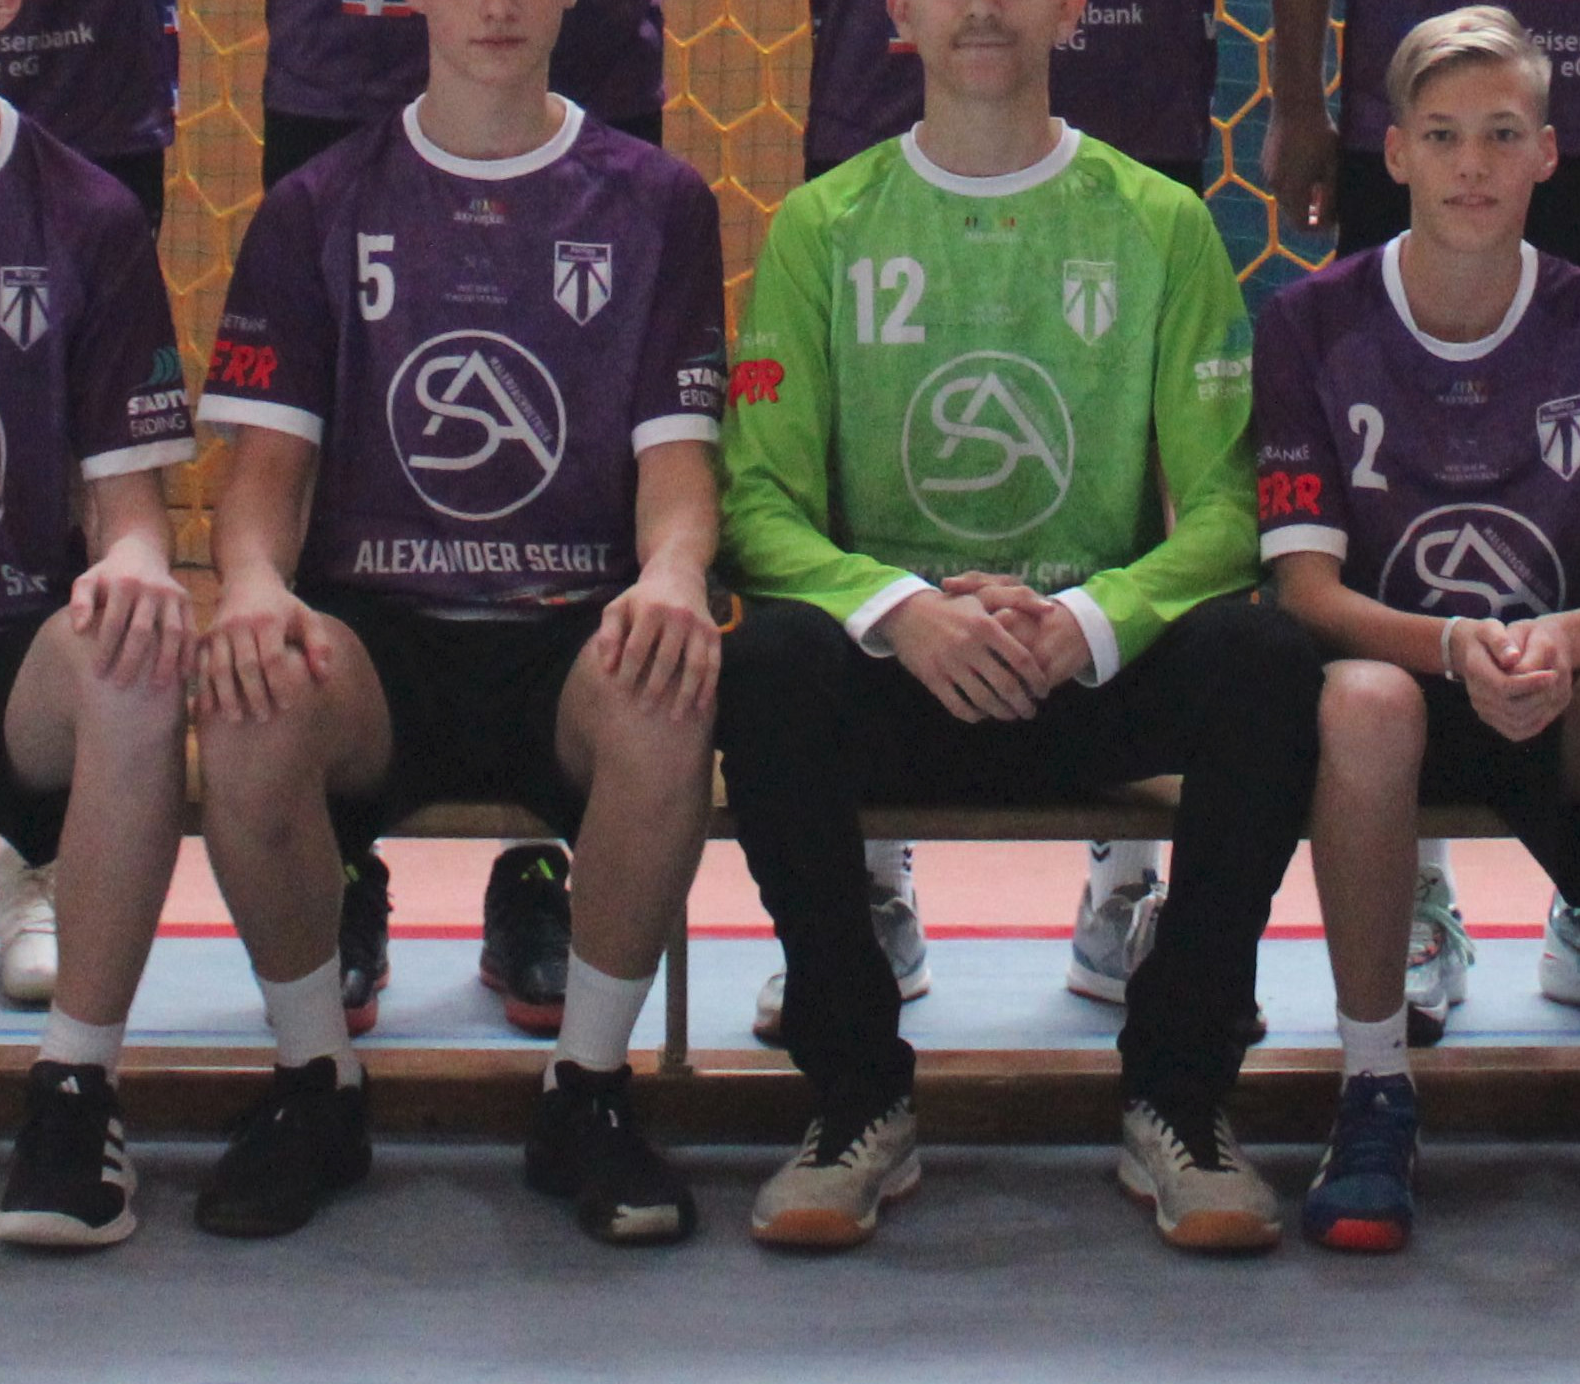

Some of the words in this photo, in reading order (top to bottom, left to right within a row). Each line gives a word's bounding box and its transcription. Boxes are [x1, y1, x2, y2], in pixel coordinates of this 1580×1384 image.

[9, 56, 40, 77] eG
[357, 232, 396, 321] 5
[848, 256, 926, 344] 12
[1348, 403, 1389, 492] 2
[355, 539, 521, 574] ALEXANDER
[526, 543, 611, 573] SEIBT
